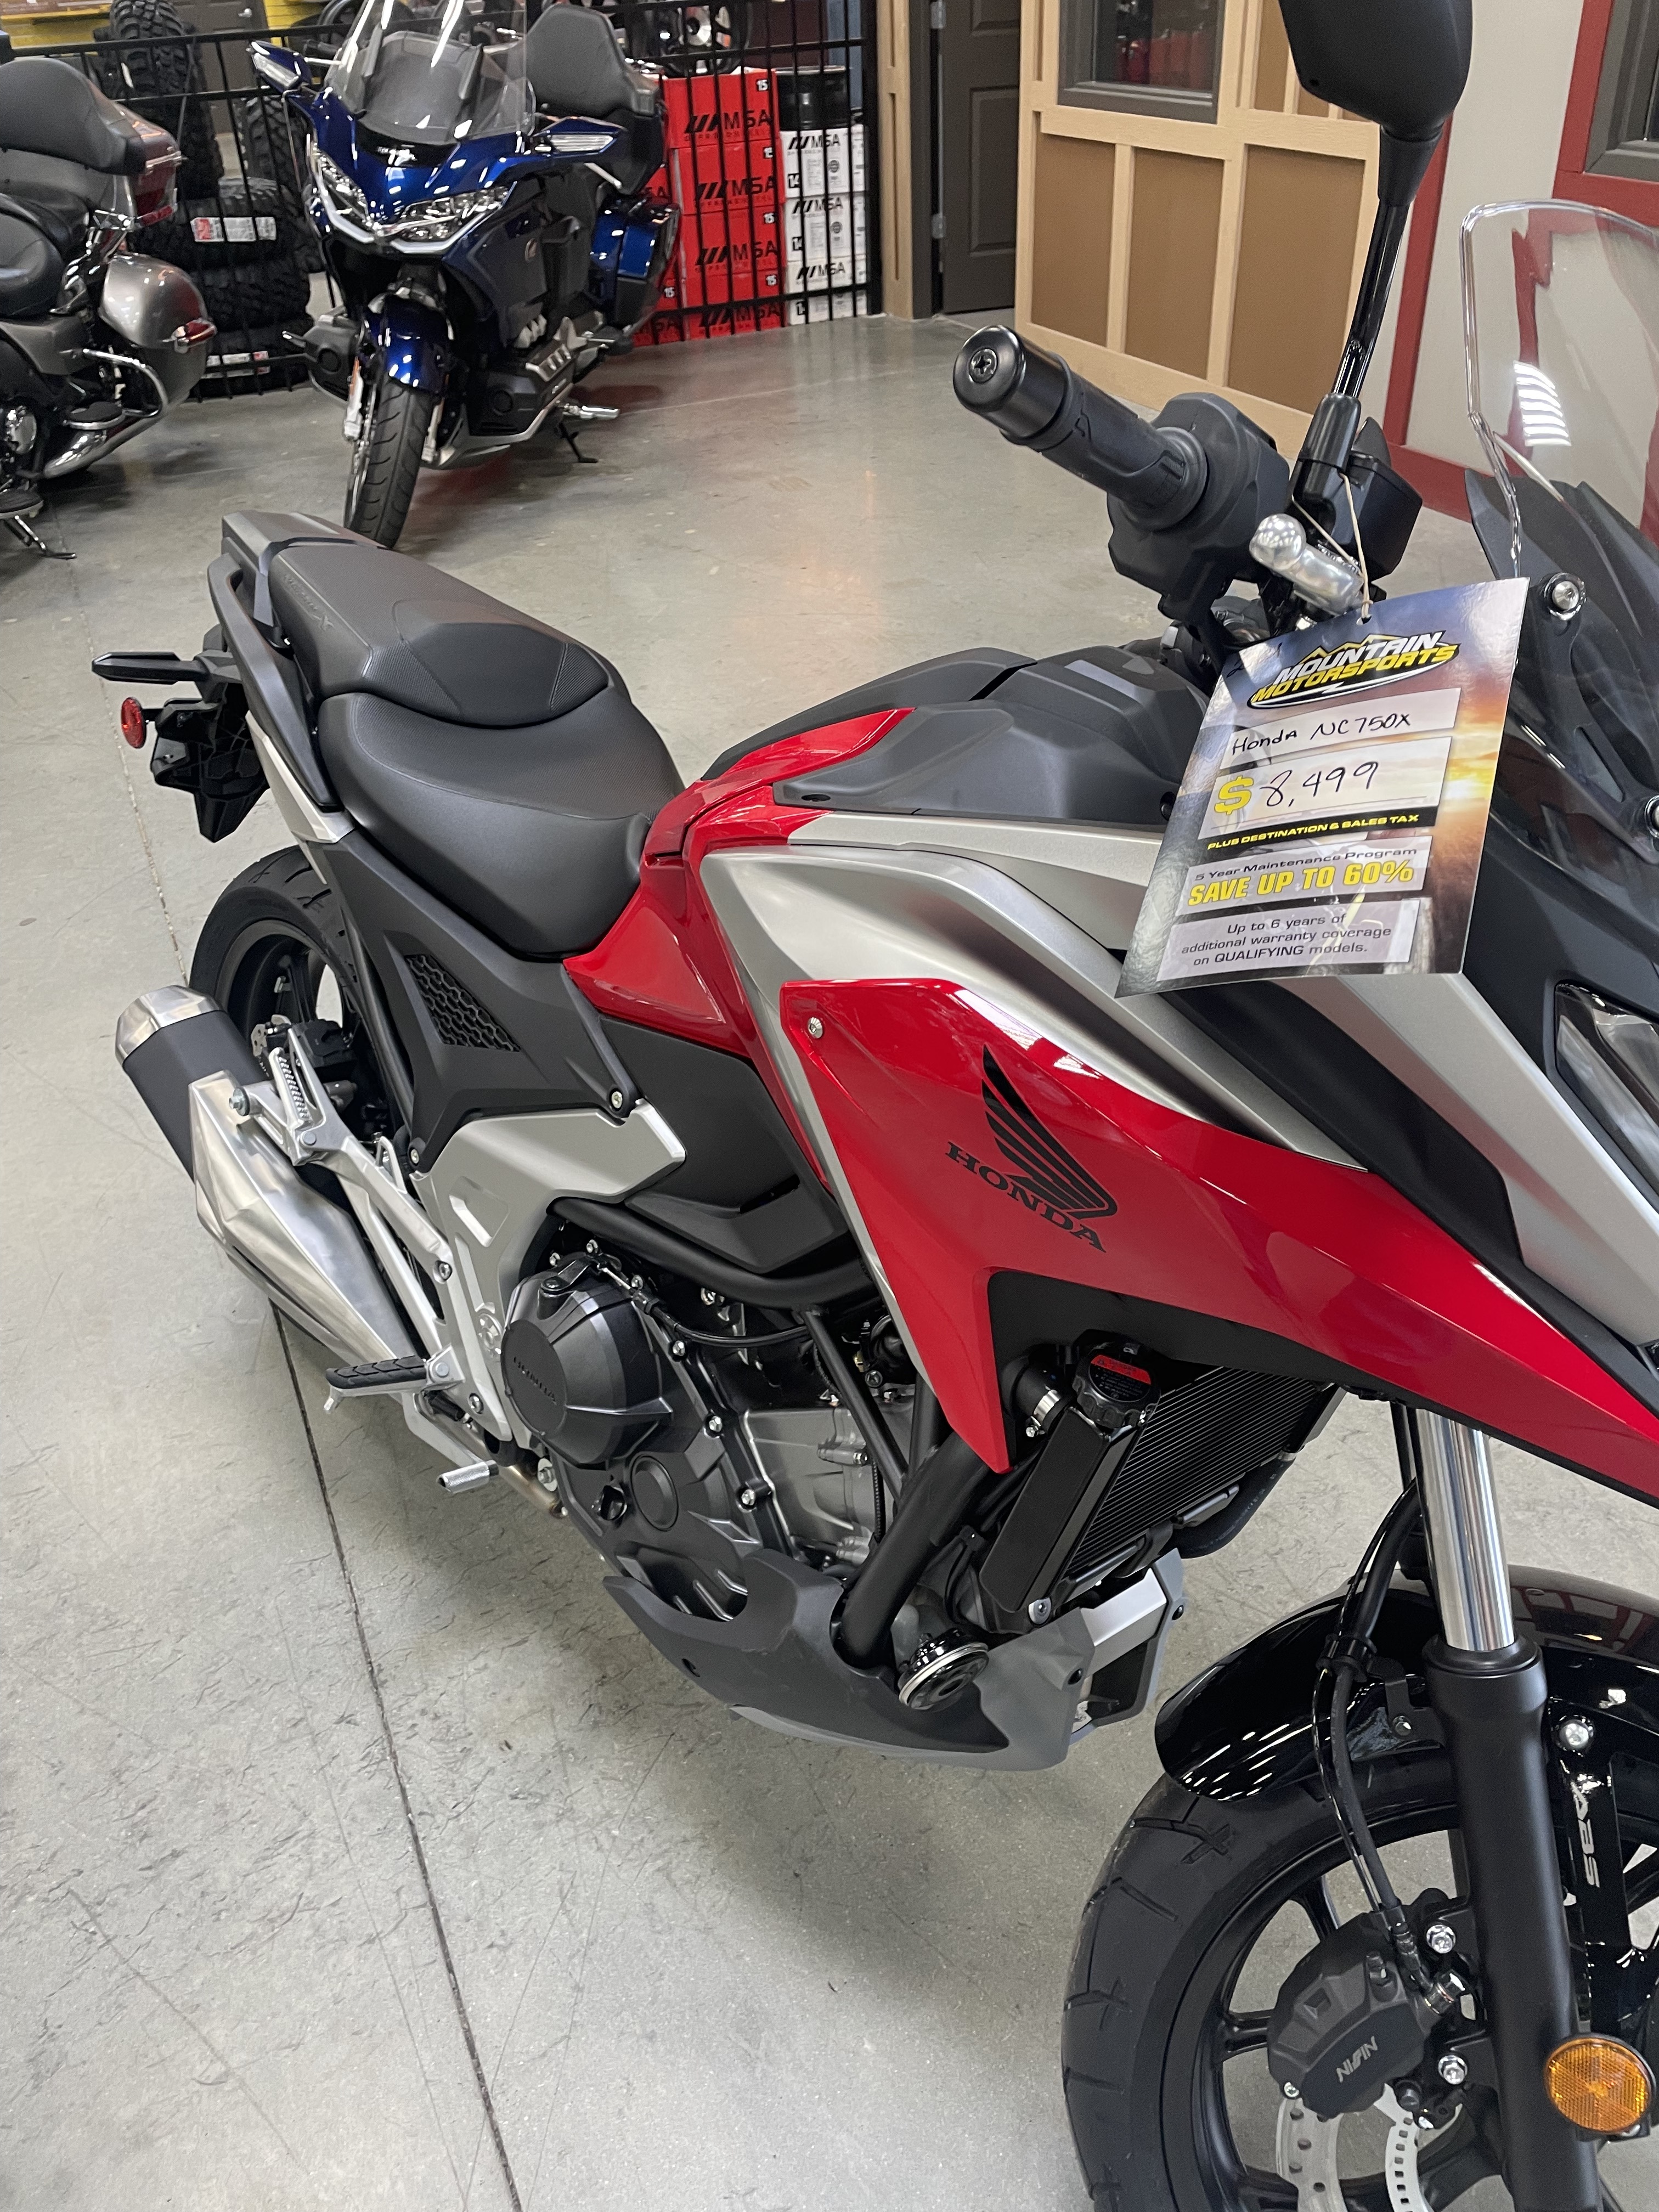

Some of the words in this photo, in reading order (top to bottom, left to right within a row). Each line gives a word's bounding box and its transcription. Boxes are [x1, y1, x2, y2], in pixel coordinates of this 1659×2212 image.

[757, 79, 768, 91] 15
[724, 109, 772, 130] MSA
[811, 133, 840, 149] MSA
[732, 176, 775, 196] MSA
[815, 197, 843, 212] MSA
[763, 212, 775, 224] 15
[733, 240, 778, 260] MSA
[818, 261, 845, 276] MSA
[766, 275, 777, 286] 15
[664, 287, 675, 298] 15
[1273, 631, 1443, 685] MOUNTAIN
[1254, 645, 1458, 702] MOTORSPORTS
[1207, 838, 1239, 850] PLUS
[1241, 823, 1328, 844] DESTINATION
[1341, 817, 1389, 828] SALES
[1390, 814, 1420, 824] TAX
[1209, 868, 1241, 877] Year
[1243, 855, 1341, 873] Maintenance
[1345, 849, 1417, 860] Program
[1188, 876, 1251, 906] SAVE
[1256, 871, 1295, 895] UP
[1302, 866, 1336, 891] TO
[1342, 859, 1414, 886] 60%
[1227, 924, 1246, 934] Up
[1251, 922, 1265, 931] to
[1271, 919, 1280, 929] 6
[1286, 916, 1325, 929] years
[1331, 913, 1347, 924] of
[1181, 936, 1246, 955] additional
[1250, 931, 1317, 945] warranty
[1322, 927, 1392, 939] coverage
[1193, 956, 1209, 966] on
[1215, 945, 1304, 963] QUALIFYING
[1308, 942, 1368, 955] models.
[945, 1141, 1107, 1253] HONDA
[1570, 1781, 1600, 1888] ABS
